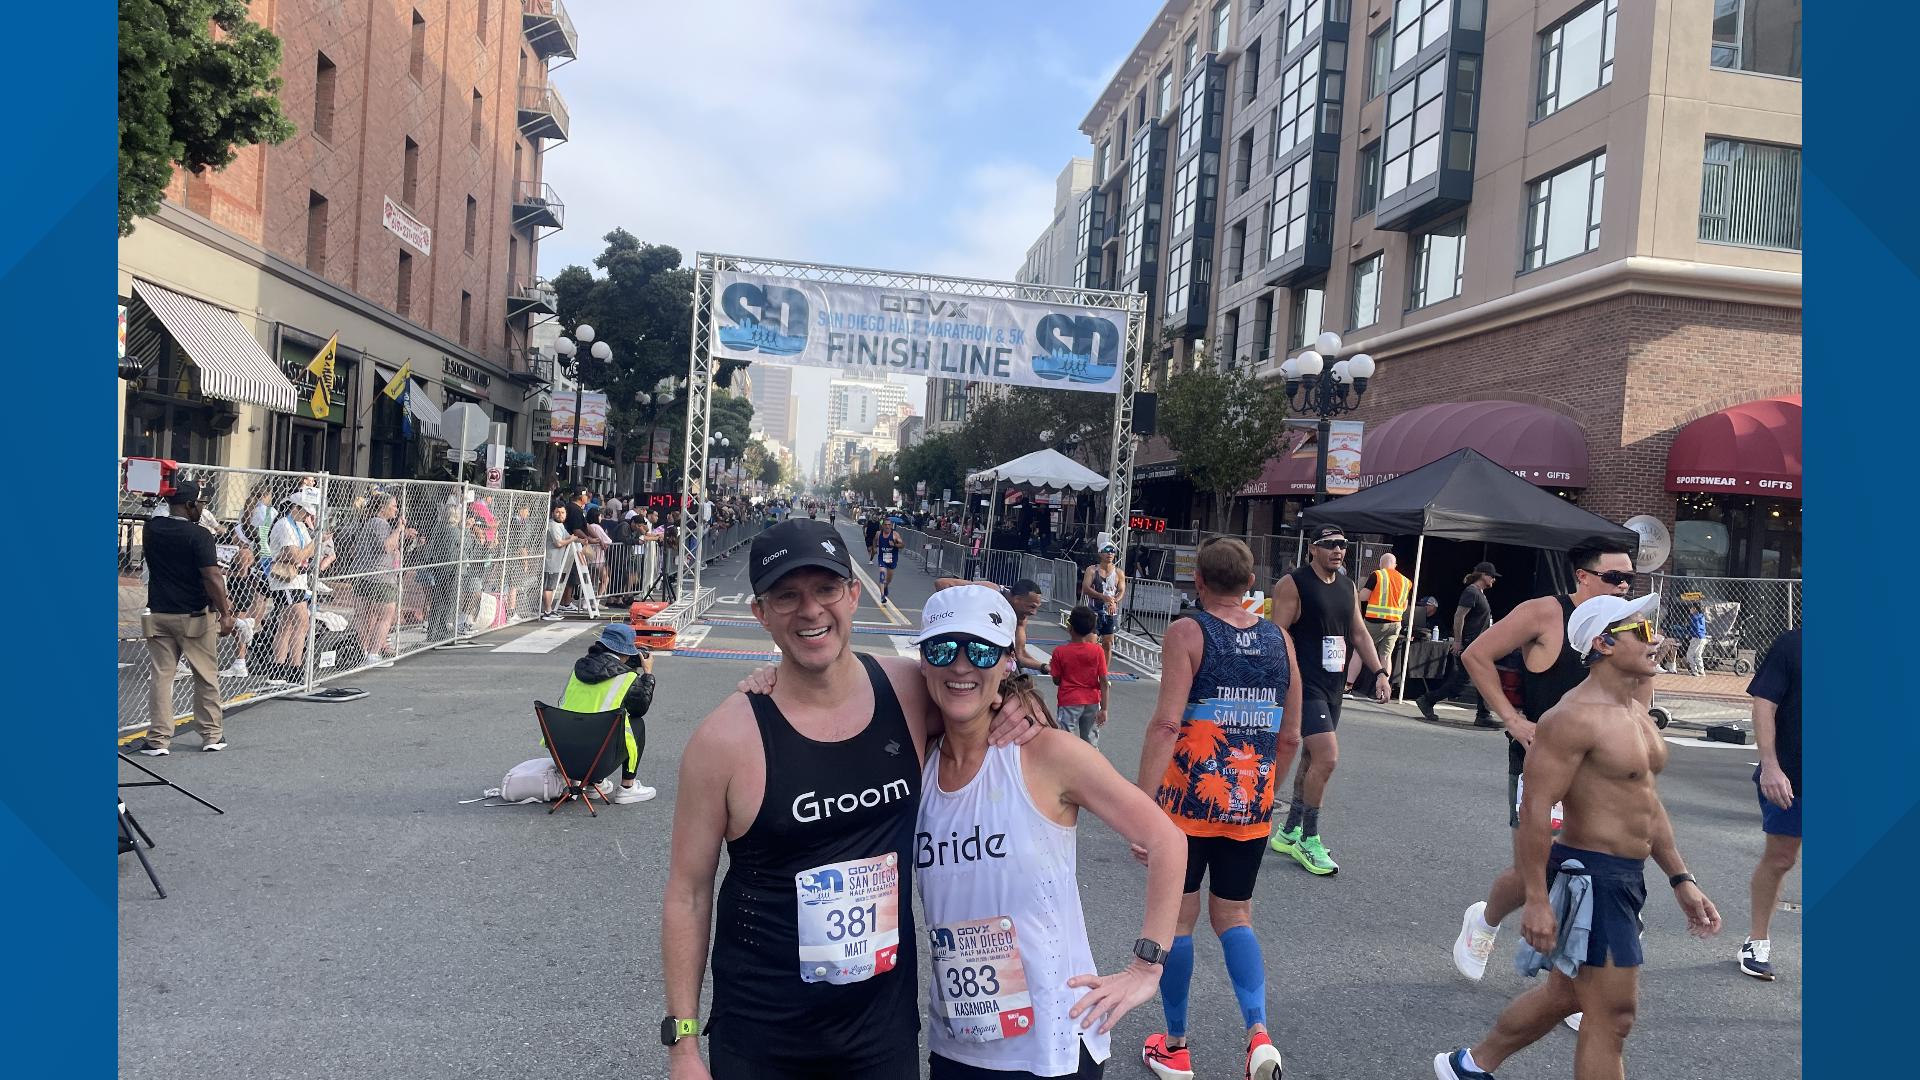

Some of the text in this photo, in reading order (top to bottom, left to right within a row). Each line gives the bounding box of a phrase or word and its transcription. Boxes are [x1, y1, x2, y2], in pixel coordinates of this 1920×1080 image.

[880, 294, 968, 319] GOVX
[720, 282, 810, 356] SD
[817, 310, 1025, 345] SAN DIEGO HALF MARATHON & 5K
[827, 332, 1013, 378] FINISH LINE
[1031, 313, 1120, 384] SD
[1546, 471, 1571, 480] GIFTS
[1676, 476, 1793, 490] SPORTSWEAR GIFTS
[762, 548, 788, 566] Groom
[929, 610, 955, 624] Bride
[1216, 685, 1277, 703] TRIATHLON
[1213, 709, 1275, 728] SAN DIEGO
[792, 778, 910, 823] Groom
[915, 825, 1007, 869] Bride
[848, 862, 882, 876] GOVX
[849, 867, 896, 890] SAN DIEGO
[849, 889, 865, 897] HALF
[866, 881, 896, 894] MARATHON
[826, 902, 877, 941] 381
[957, 924, 990, 936] GOVX
[844, 939, 868, 958] MATT
[958, 931, 1013, 950] SAN DIEGO
[960, 944, 1014, 957] HALF MARATHON
[946, 964, 1000, 998] 383
[954, 999, 1000, 1017] KASANDRA
[971, 1024, 997, 1036] Legacy
